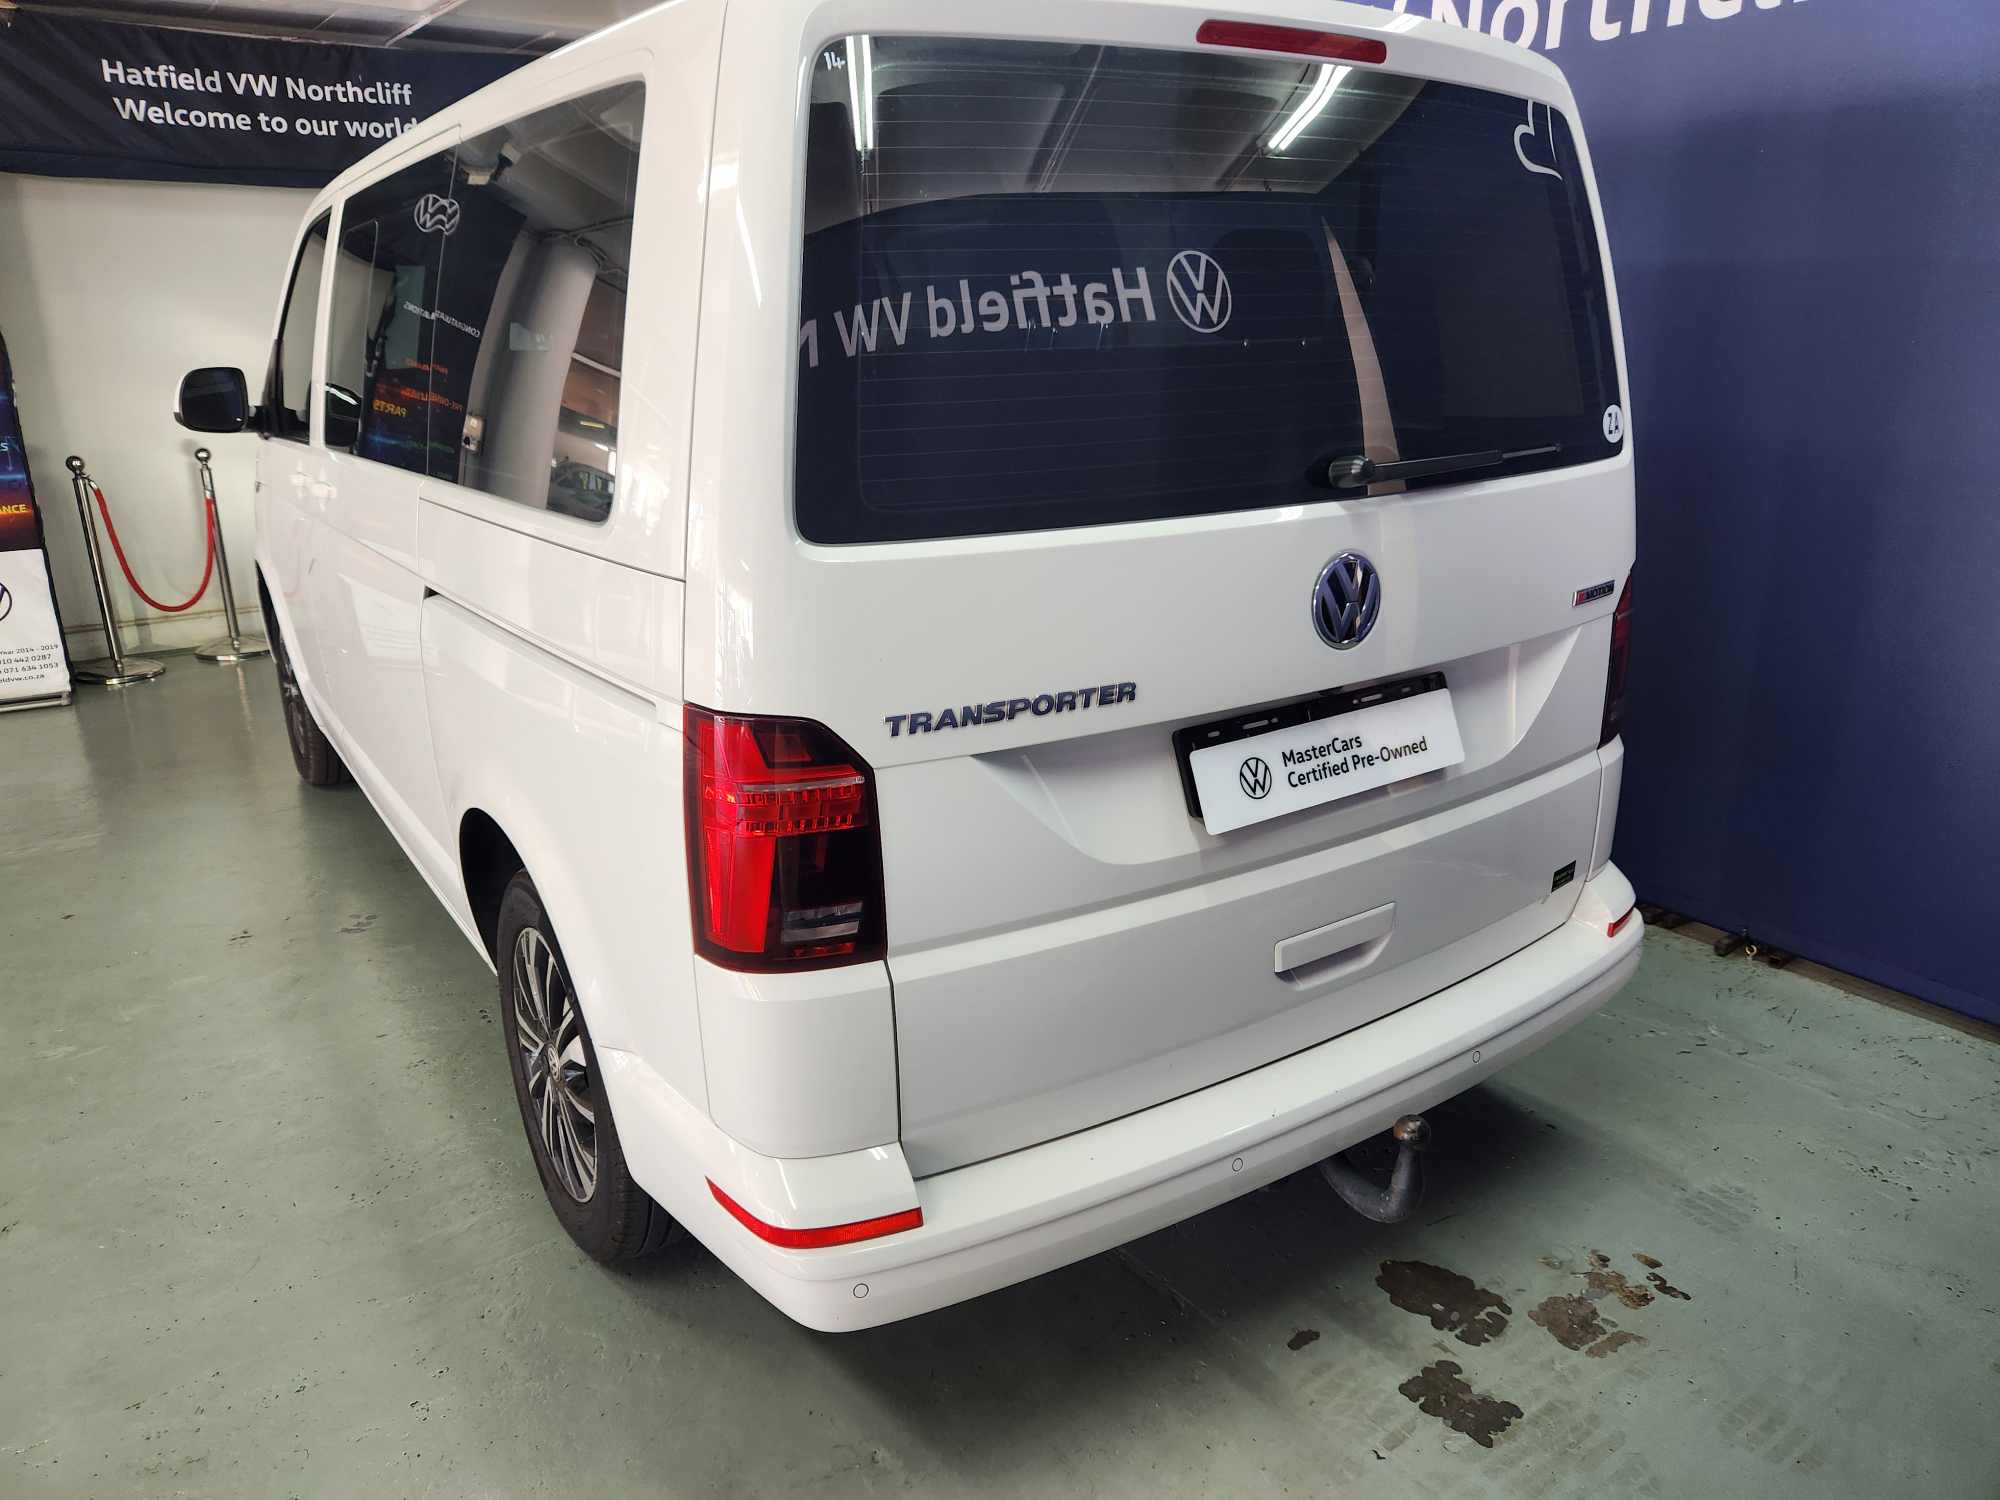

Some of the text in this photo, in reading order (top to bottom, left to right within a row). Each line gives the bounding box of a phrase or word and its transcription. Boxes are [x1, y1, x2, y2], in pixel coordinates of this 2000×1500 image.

[101, 59, 412, 106] Hatfield VW Northcliff
[113, 96, 251, 131] Welcome
[257, 112, 289, 134] to
[294, 116, 339, 137] our
[884, 681, 1137, 737] TRANSPORTER
[1281, 735, 1363, 767] MasterCars
[1287, 736, 1428, 788] Certified Pre-Owned
